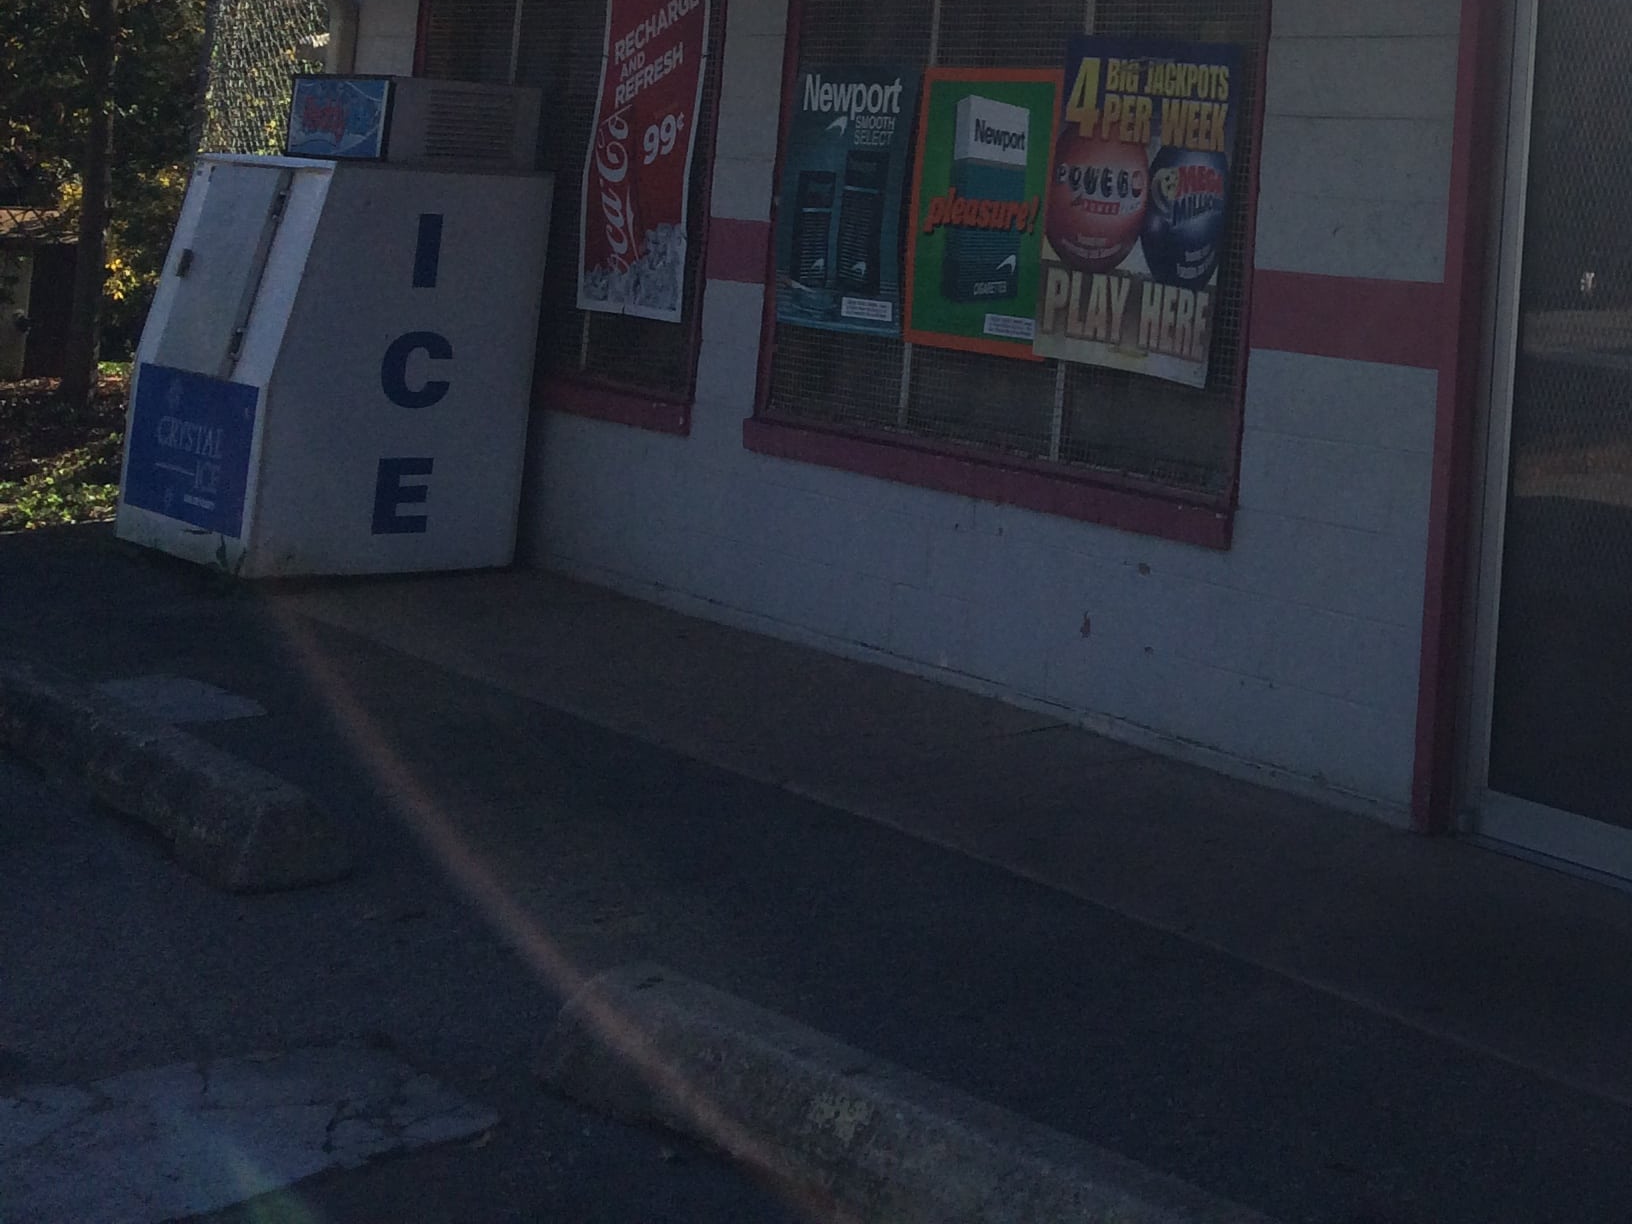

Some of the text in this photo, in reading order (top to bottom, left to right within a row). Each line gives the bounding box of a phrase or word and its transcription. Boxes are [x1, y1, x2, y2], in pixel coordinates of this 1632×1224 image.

[613, 41, 684, 110] REFRESH
[620, 51, 646, 81] AND
[803, 73, 903, 121] Newport
[1065, 56, 1230, 138] 4 BIG JACKPOTS
[853, 130, 894, 146] SELECT
[855, 116, 897, 130] SMOOTH
[974, 118, 1025, 152] Newport
[1101, 93, 1228, 152] PER WEEK
[923, 186, 1041, 235] pleasure!
[1042, 266, 1210, 361] PLAY HERE
[371, 214, 453, 535] ICE
